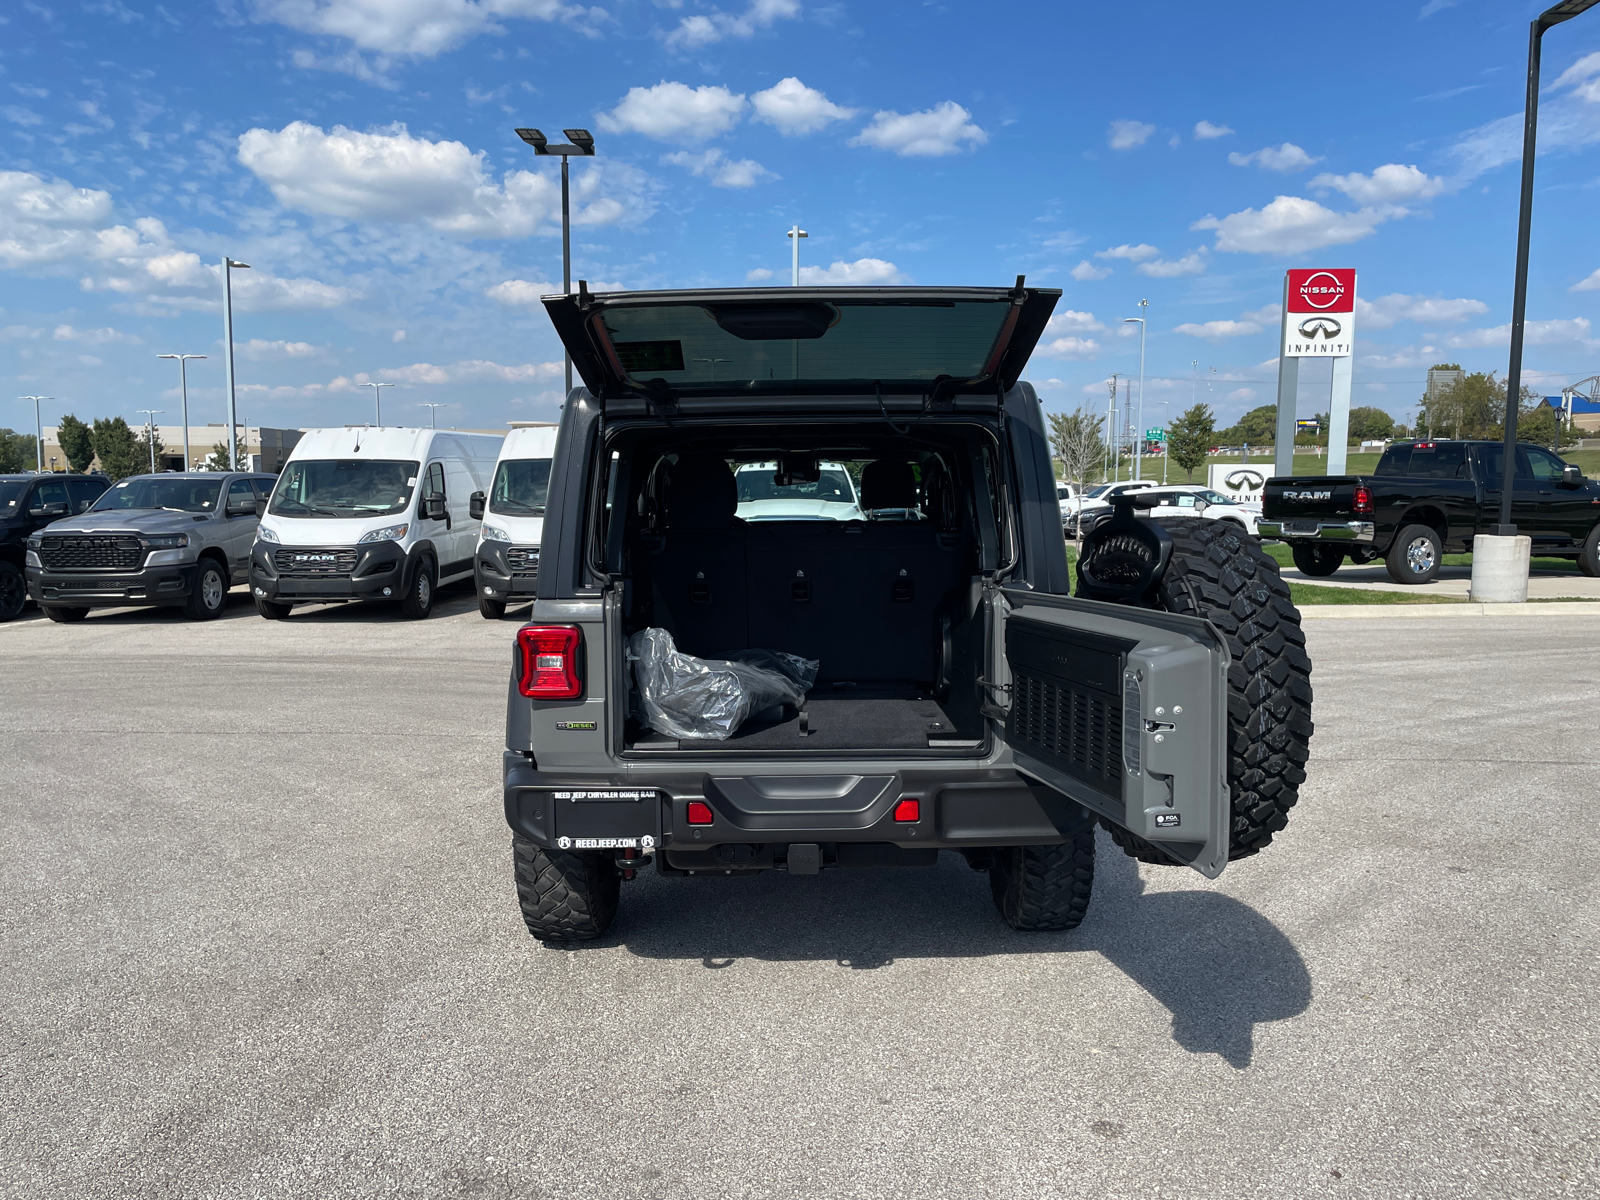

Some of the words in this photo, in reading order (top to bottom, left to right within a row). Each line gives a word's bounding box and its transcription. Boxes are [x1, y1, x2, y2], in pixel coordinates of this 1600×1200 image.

[1300, 286, 1345, 294] NISSAN
[1288, 344, 1350, 353] INFINITI
[1282, 491, 1331, 500] RAM
[62, 540, 111, 548] RAM
[576, 838, 637, 848] REEDJEEP.COM
